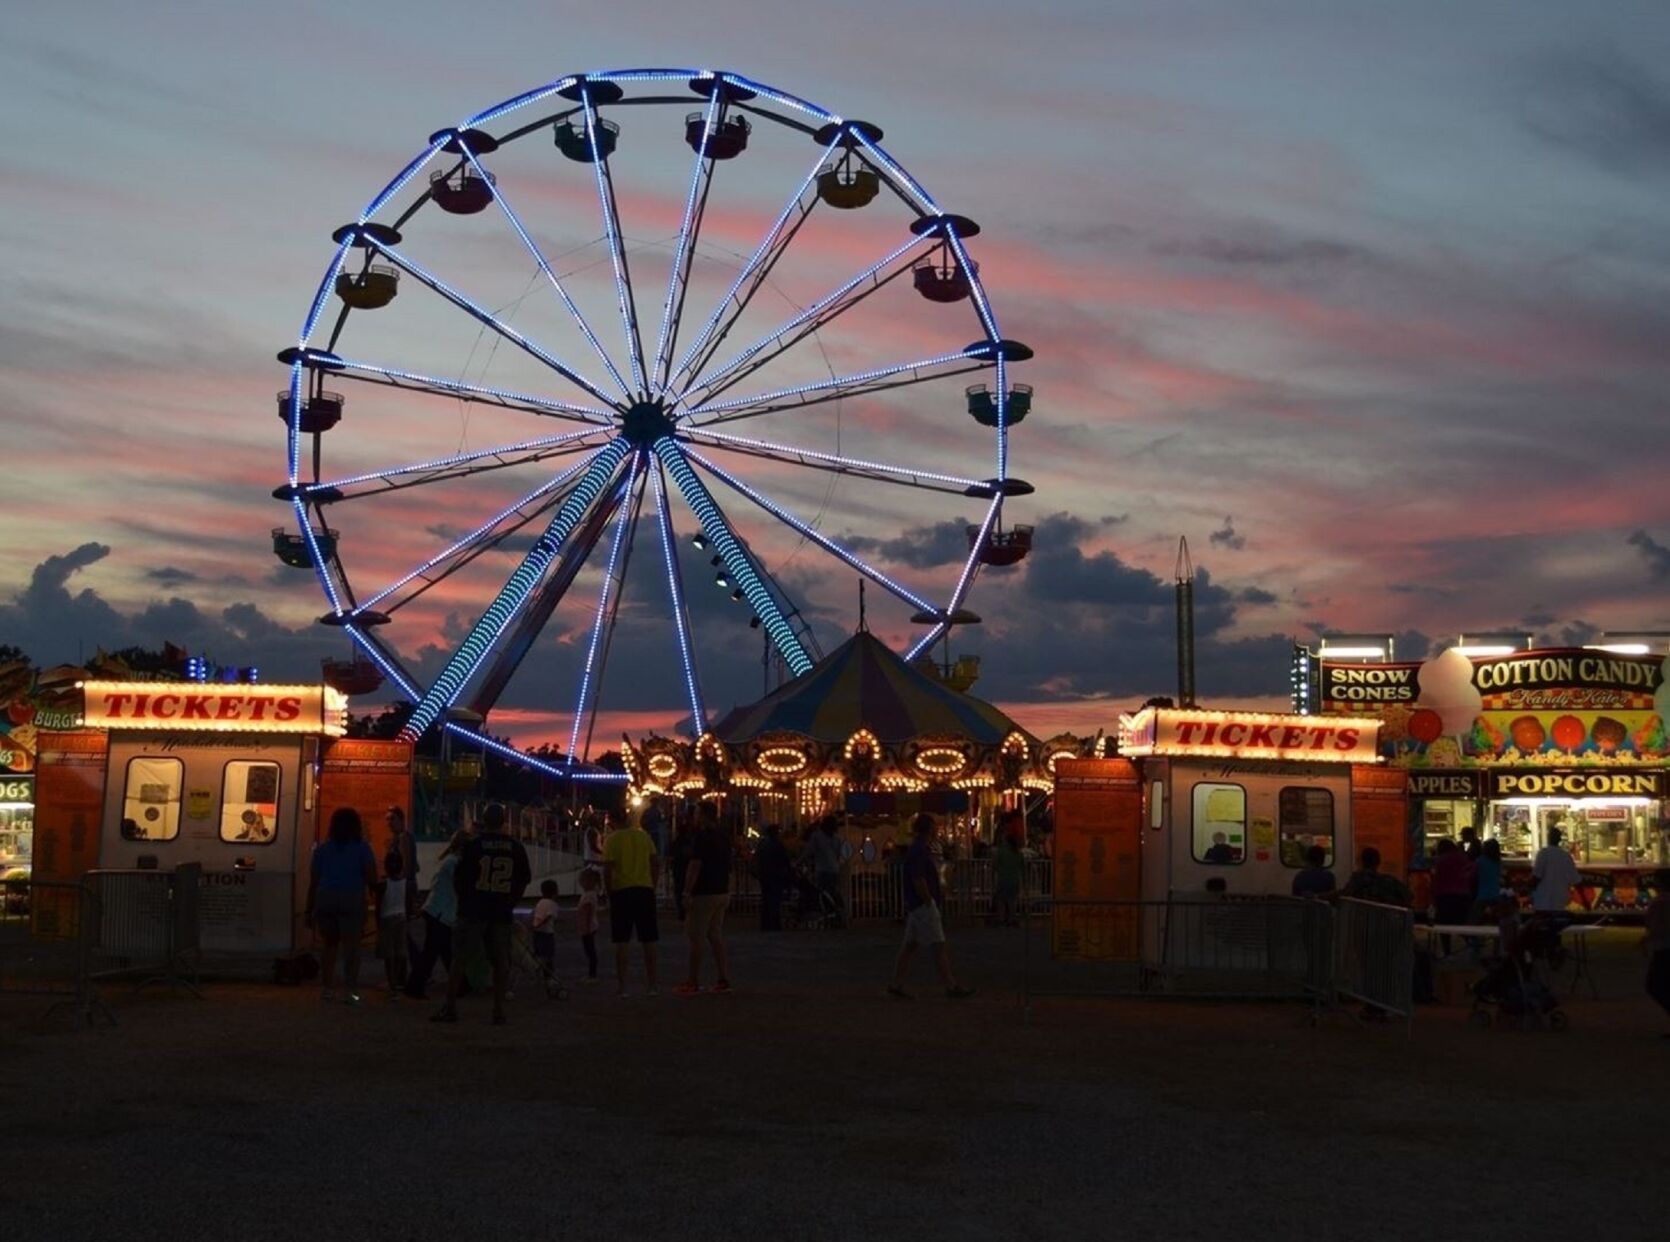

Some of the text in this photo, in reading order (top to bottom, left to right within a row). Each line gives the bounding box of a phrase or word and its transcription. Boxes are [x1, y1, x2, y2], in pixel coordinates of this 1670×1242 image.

[1330, 669, 1411, 683] SNOW
[1476, 657, 1658, 689] COTTON CANDY
[1330, 686, 1412, 700] CONES
[103, 694, 301, 721] TICKETS
[1175, 721, 1360, 750] TICKETS
[1407, 776, 1473, 794] APPLES
[1497, 774, 1657, 794] POPCORN
[476, 856, 513, 893] 12
